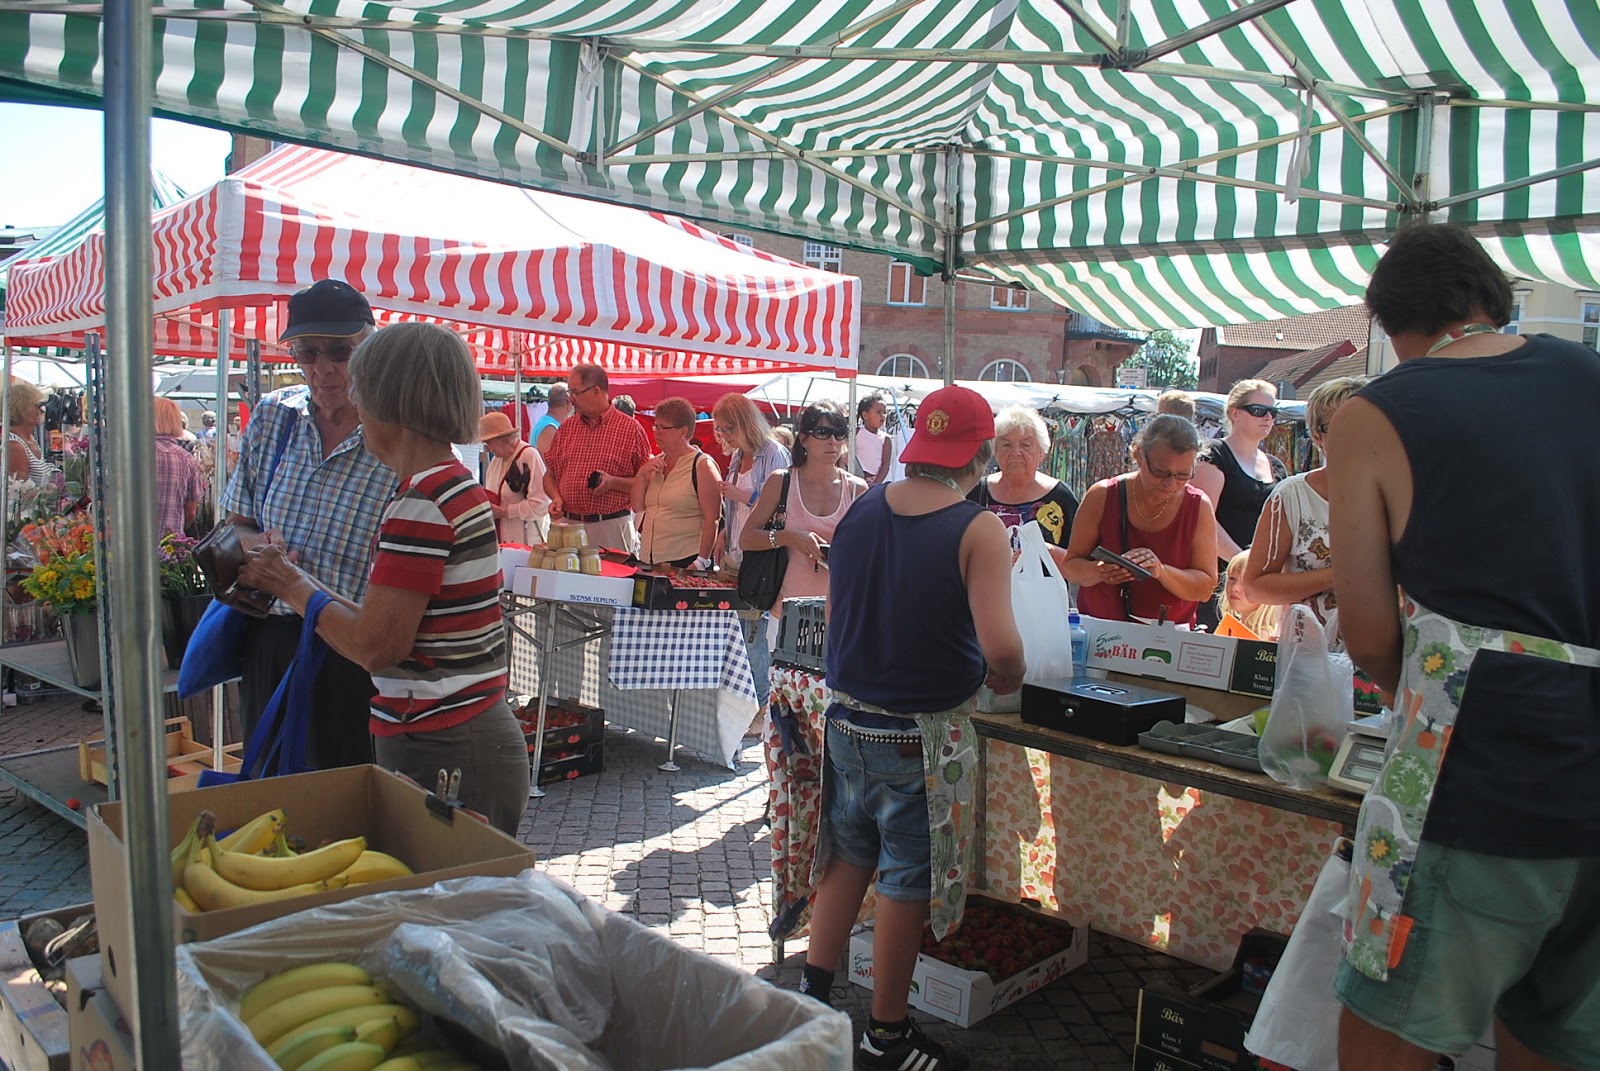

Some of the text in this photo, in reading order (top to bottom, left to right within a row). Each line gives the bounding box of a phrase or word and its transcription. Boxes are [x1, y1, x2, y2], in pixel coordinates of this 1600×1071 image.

[569, 594, 618, 604] SVENSK HONUNG
[1112, 644, 1137, 660] BÄR
[1253, 673, 1269, 682] Klass
[1253, 682, 1273, 691] Sverige
[1160, 1007, 1184, 1025] Bär
[1161, 1032, 1177, 1043] Klass
[1160, 1040, 1181, 1053] Sverige
